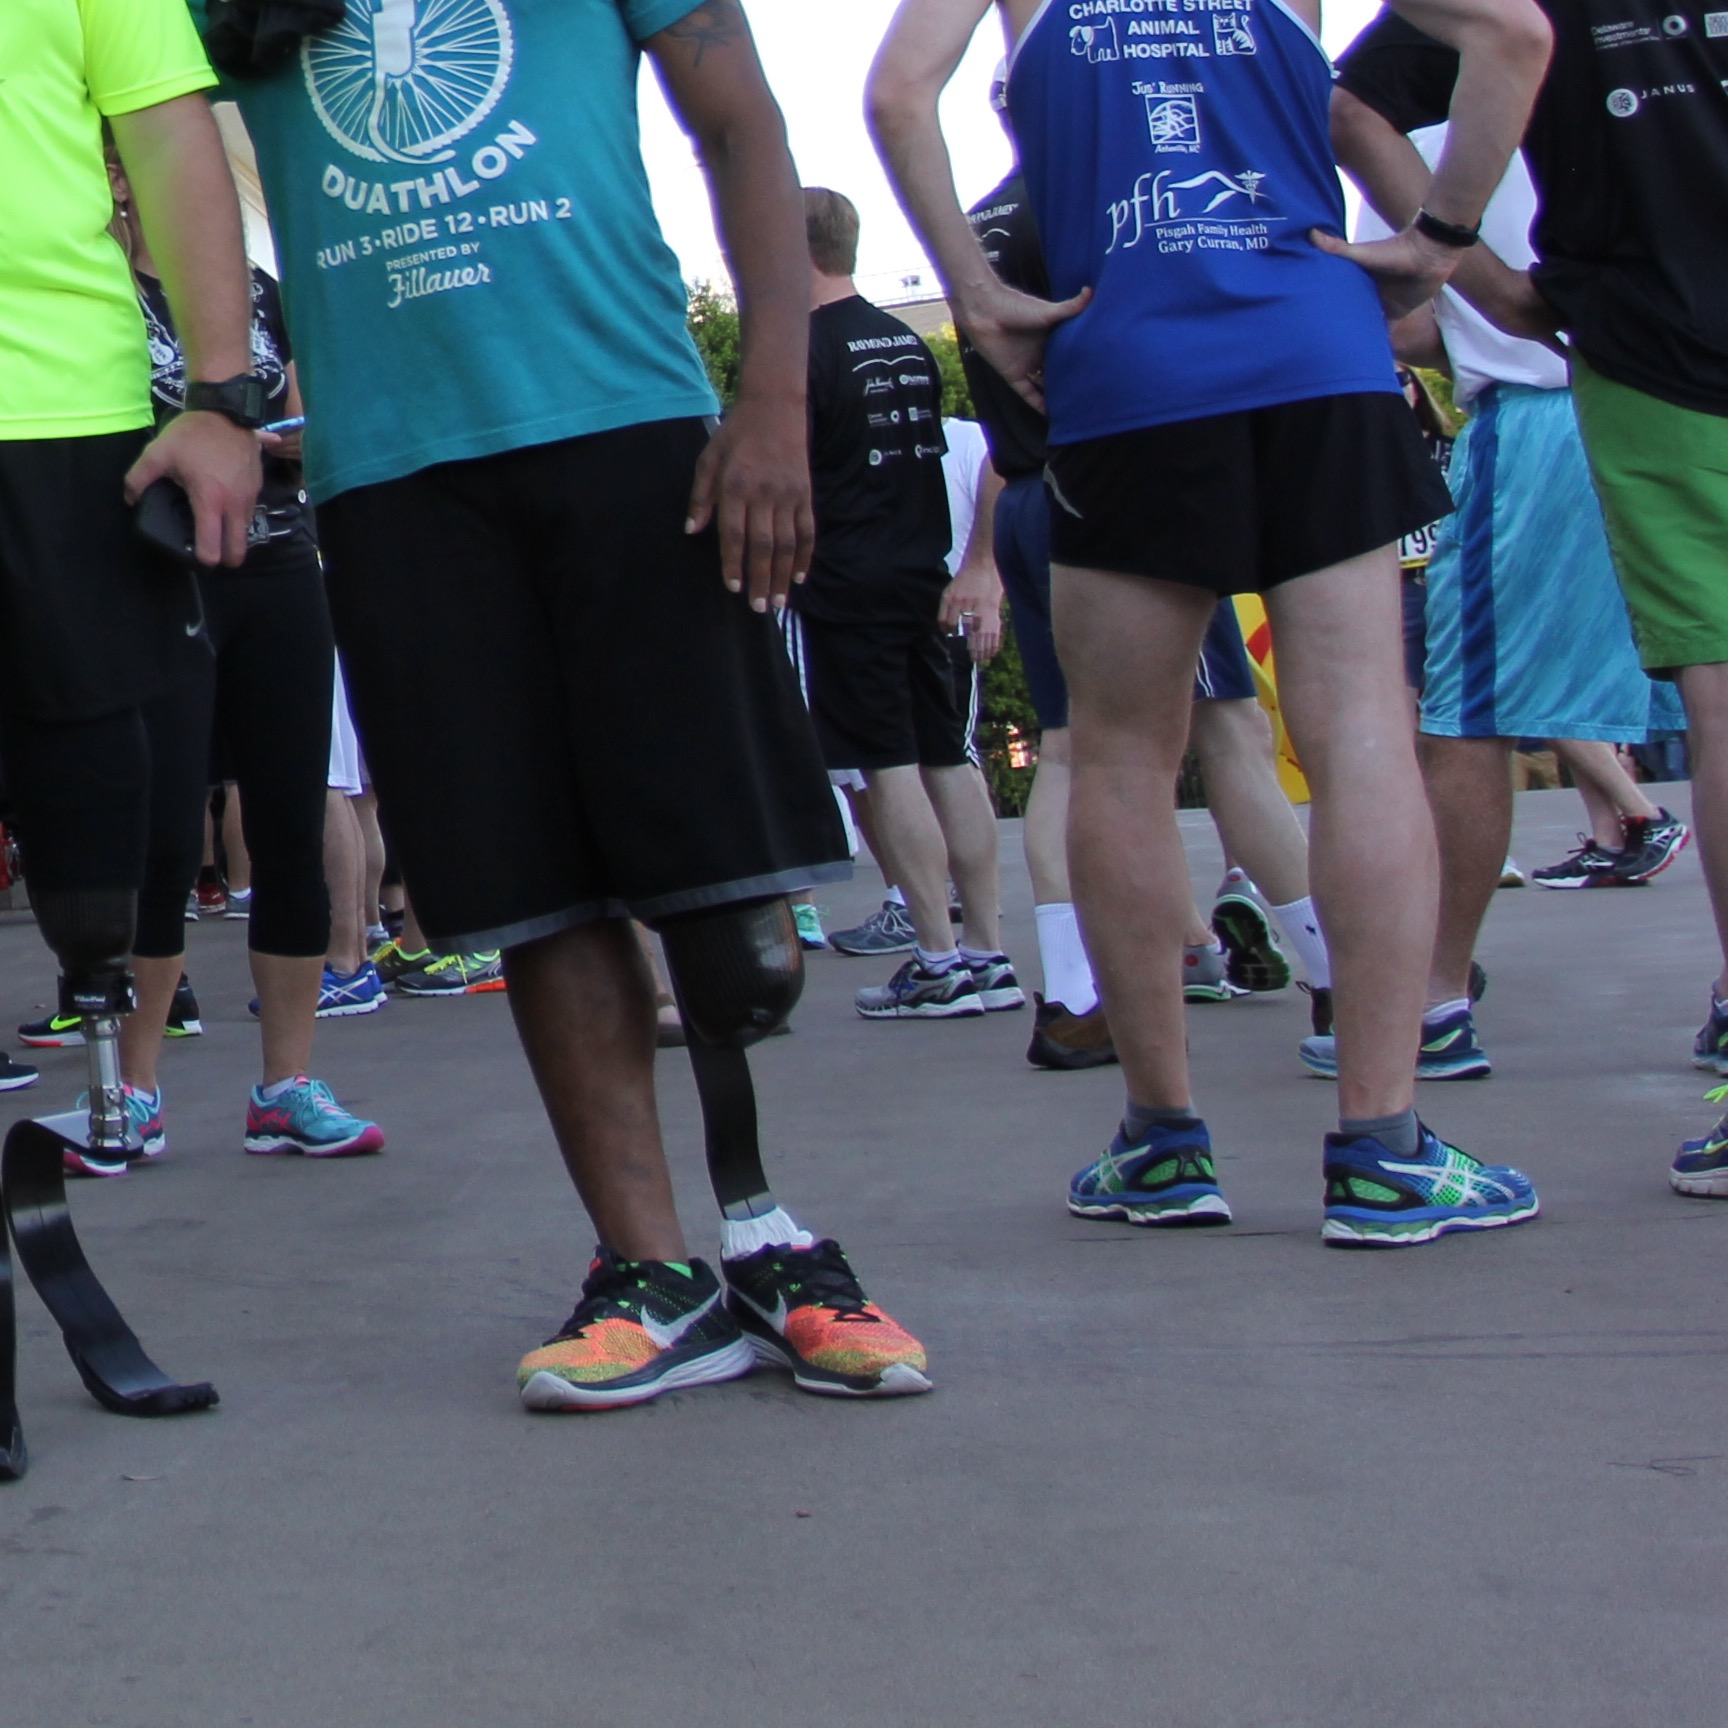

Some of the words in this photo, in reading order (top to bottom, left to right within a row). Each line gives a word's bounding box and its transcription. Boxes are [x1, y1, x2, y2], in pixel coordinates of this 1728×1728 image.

[1127, 19, 1200, 37] ANIMAL
[1122, 42, 1211, 59] HOSPITAL
[320, 118, 540, 217] DUATHLON
[1104, 169, 1181, 255] pfh
[316, 239, 357, 271] RUN
[554, 197, 573, 219] 2
[1155, 223, 1195, 240] Pisgah
[1197, 224, 1229, 238] Family
[1230, 223, 1268, 236] Health
[385, 245, 458, 271] PRESENTED
[460, 241, 481, 256] BY
[1157, 238, 1194, 254] Gary
[1197, 236, 1244, 252] Curran,
[1245, 236, 1269, 250] MD
